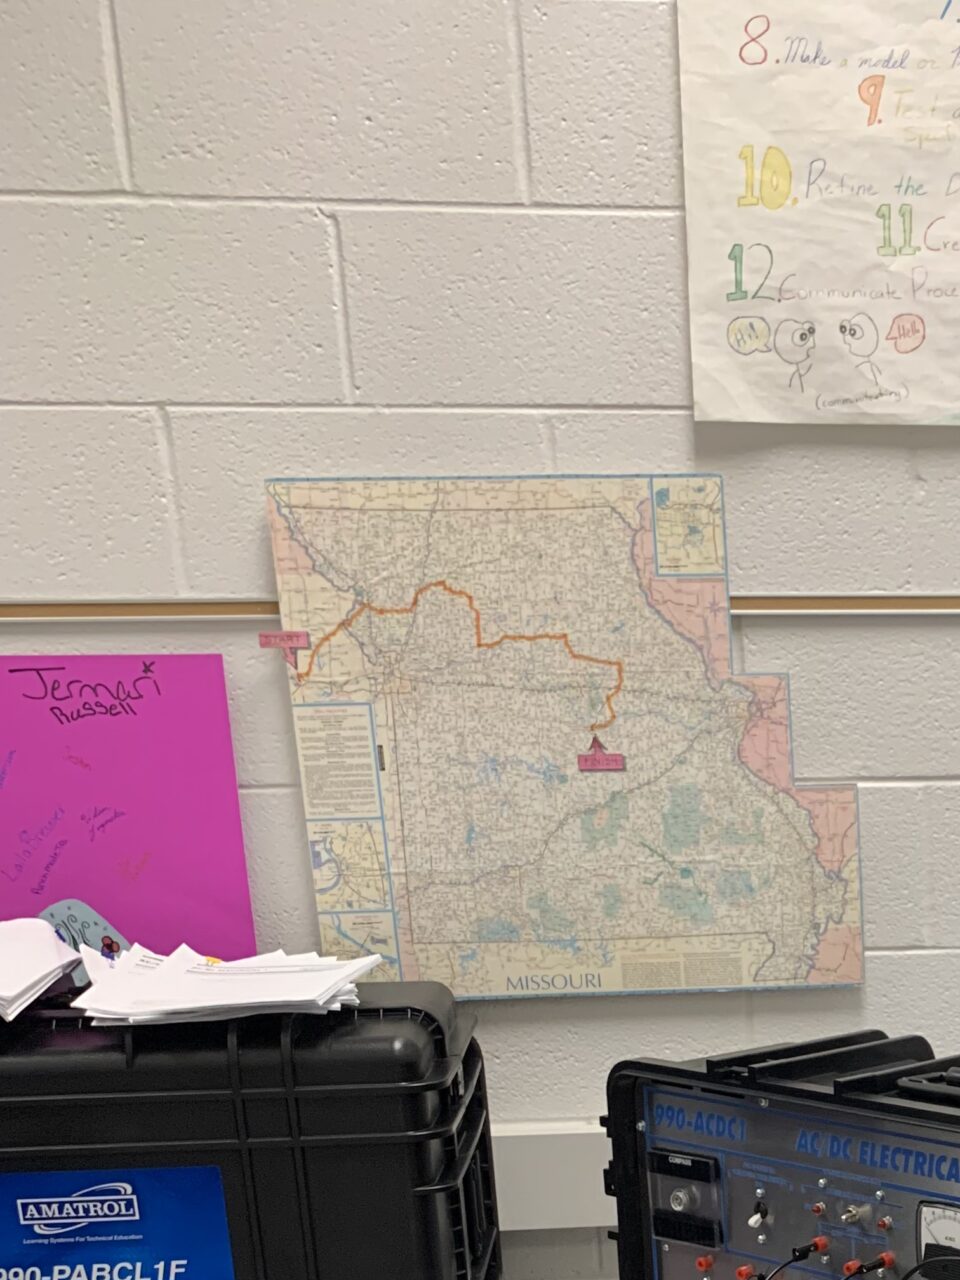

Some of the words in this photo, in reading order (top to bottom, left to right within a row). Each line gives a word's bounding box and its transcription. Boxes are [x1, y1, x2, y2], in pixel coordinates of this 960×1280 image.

[857, 49, 911, 70] model
[916, 59, 940, 70] or
[737, 144, 799, 210] 10.
[893, 176, 929, 197] the
[779, 273, 902, 302] Communicate
[506, 973, 602, 991] MISSOURI
[24, 1201, 134, 1219] AMATROL
